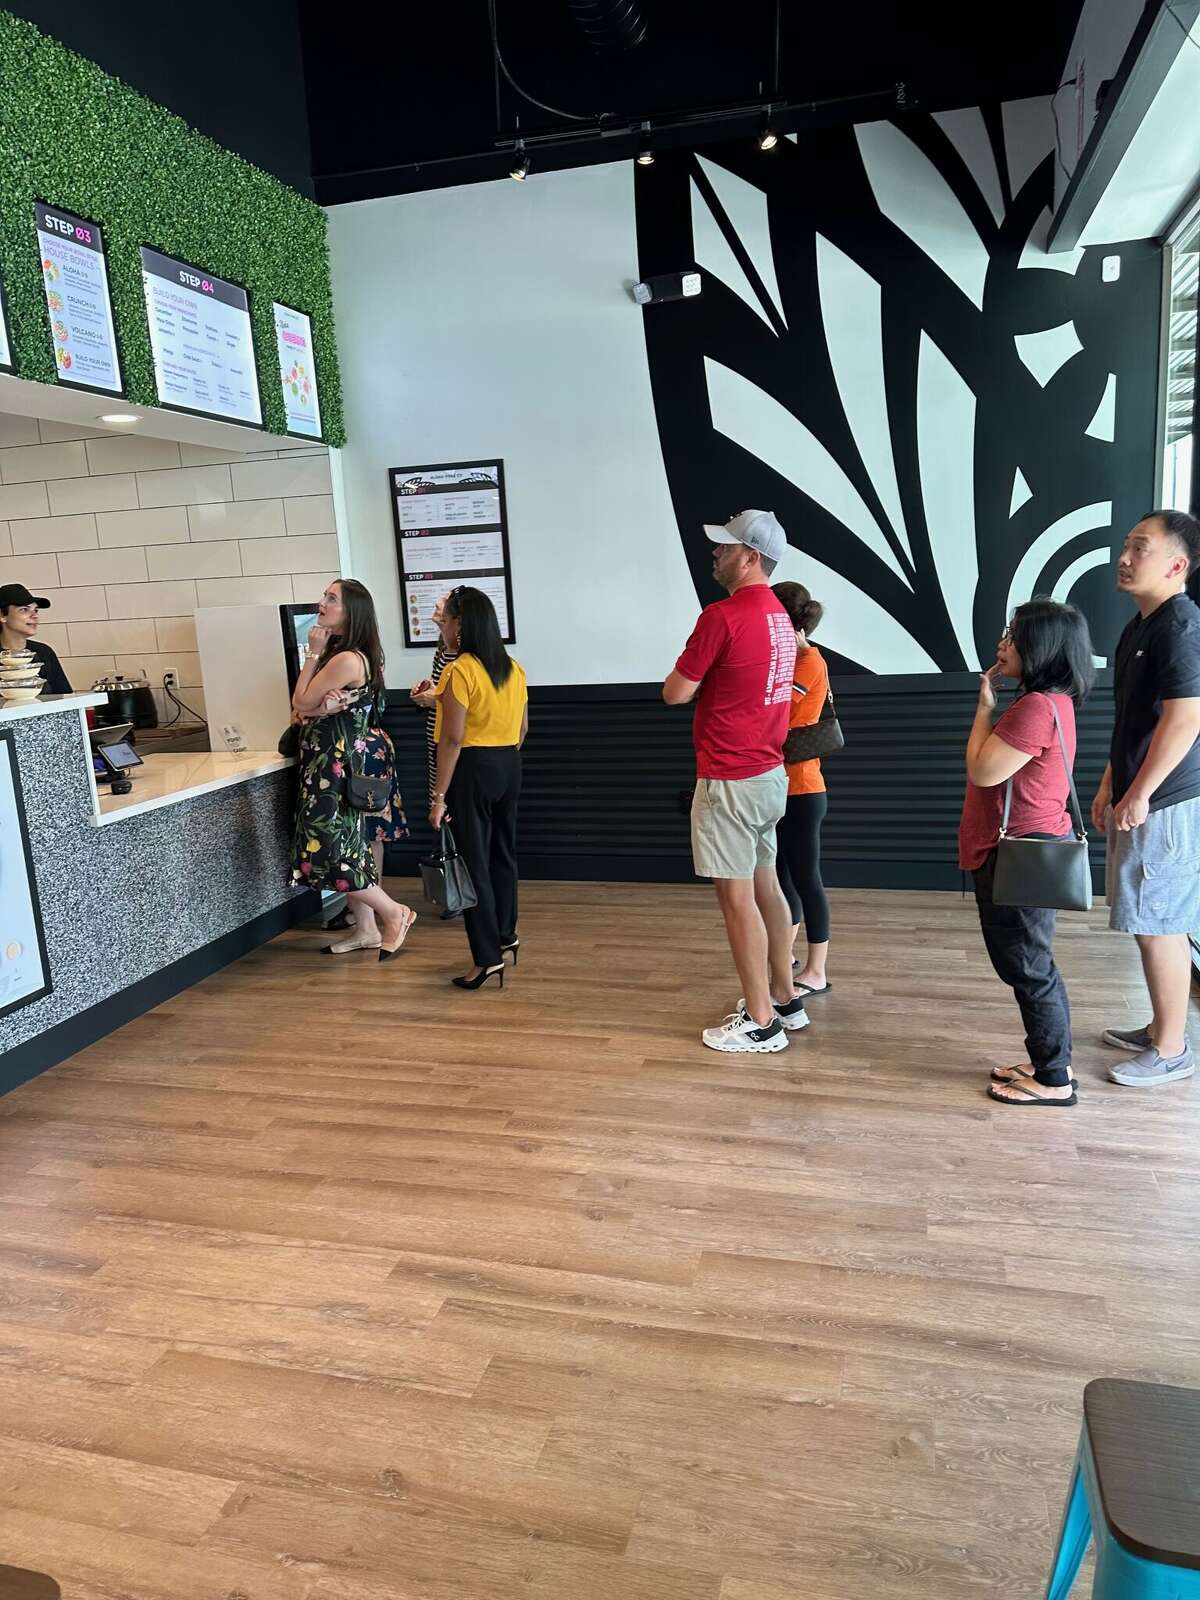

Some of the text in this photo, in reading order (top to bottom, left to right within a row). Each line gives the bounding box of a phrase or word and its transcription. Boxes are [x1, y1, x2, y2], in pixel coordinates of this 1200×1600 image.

[45, 214, 92, 243] STEP 03
[179, 270, 215, 294] STEP 04
[401, 488, 417, 496] STEP
